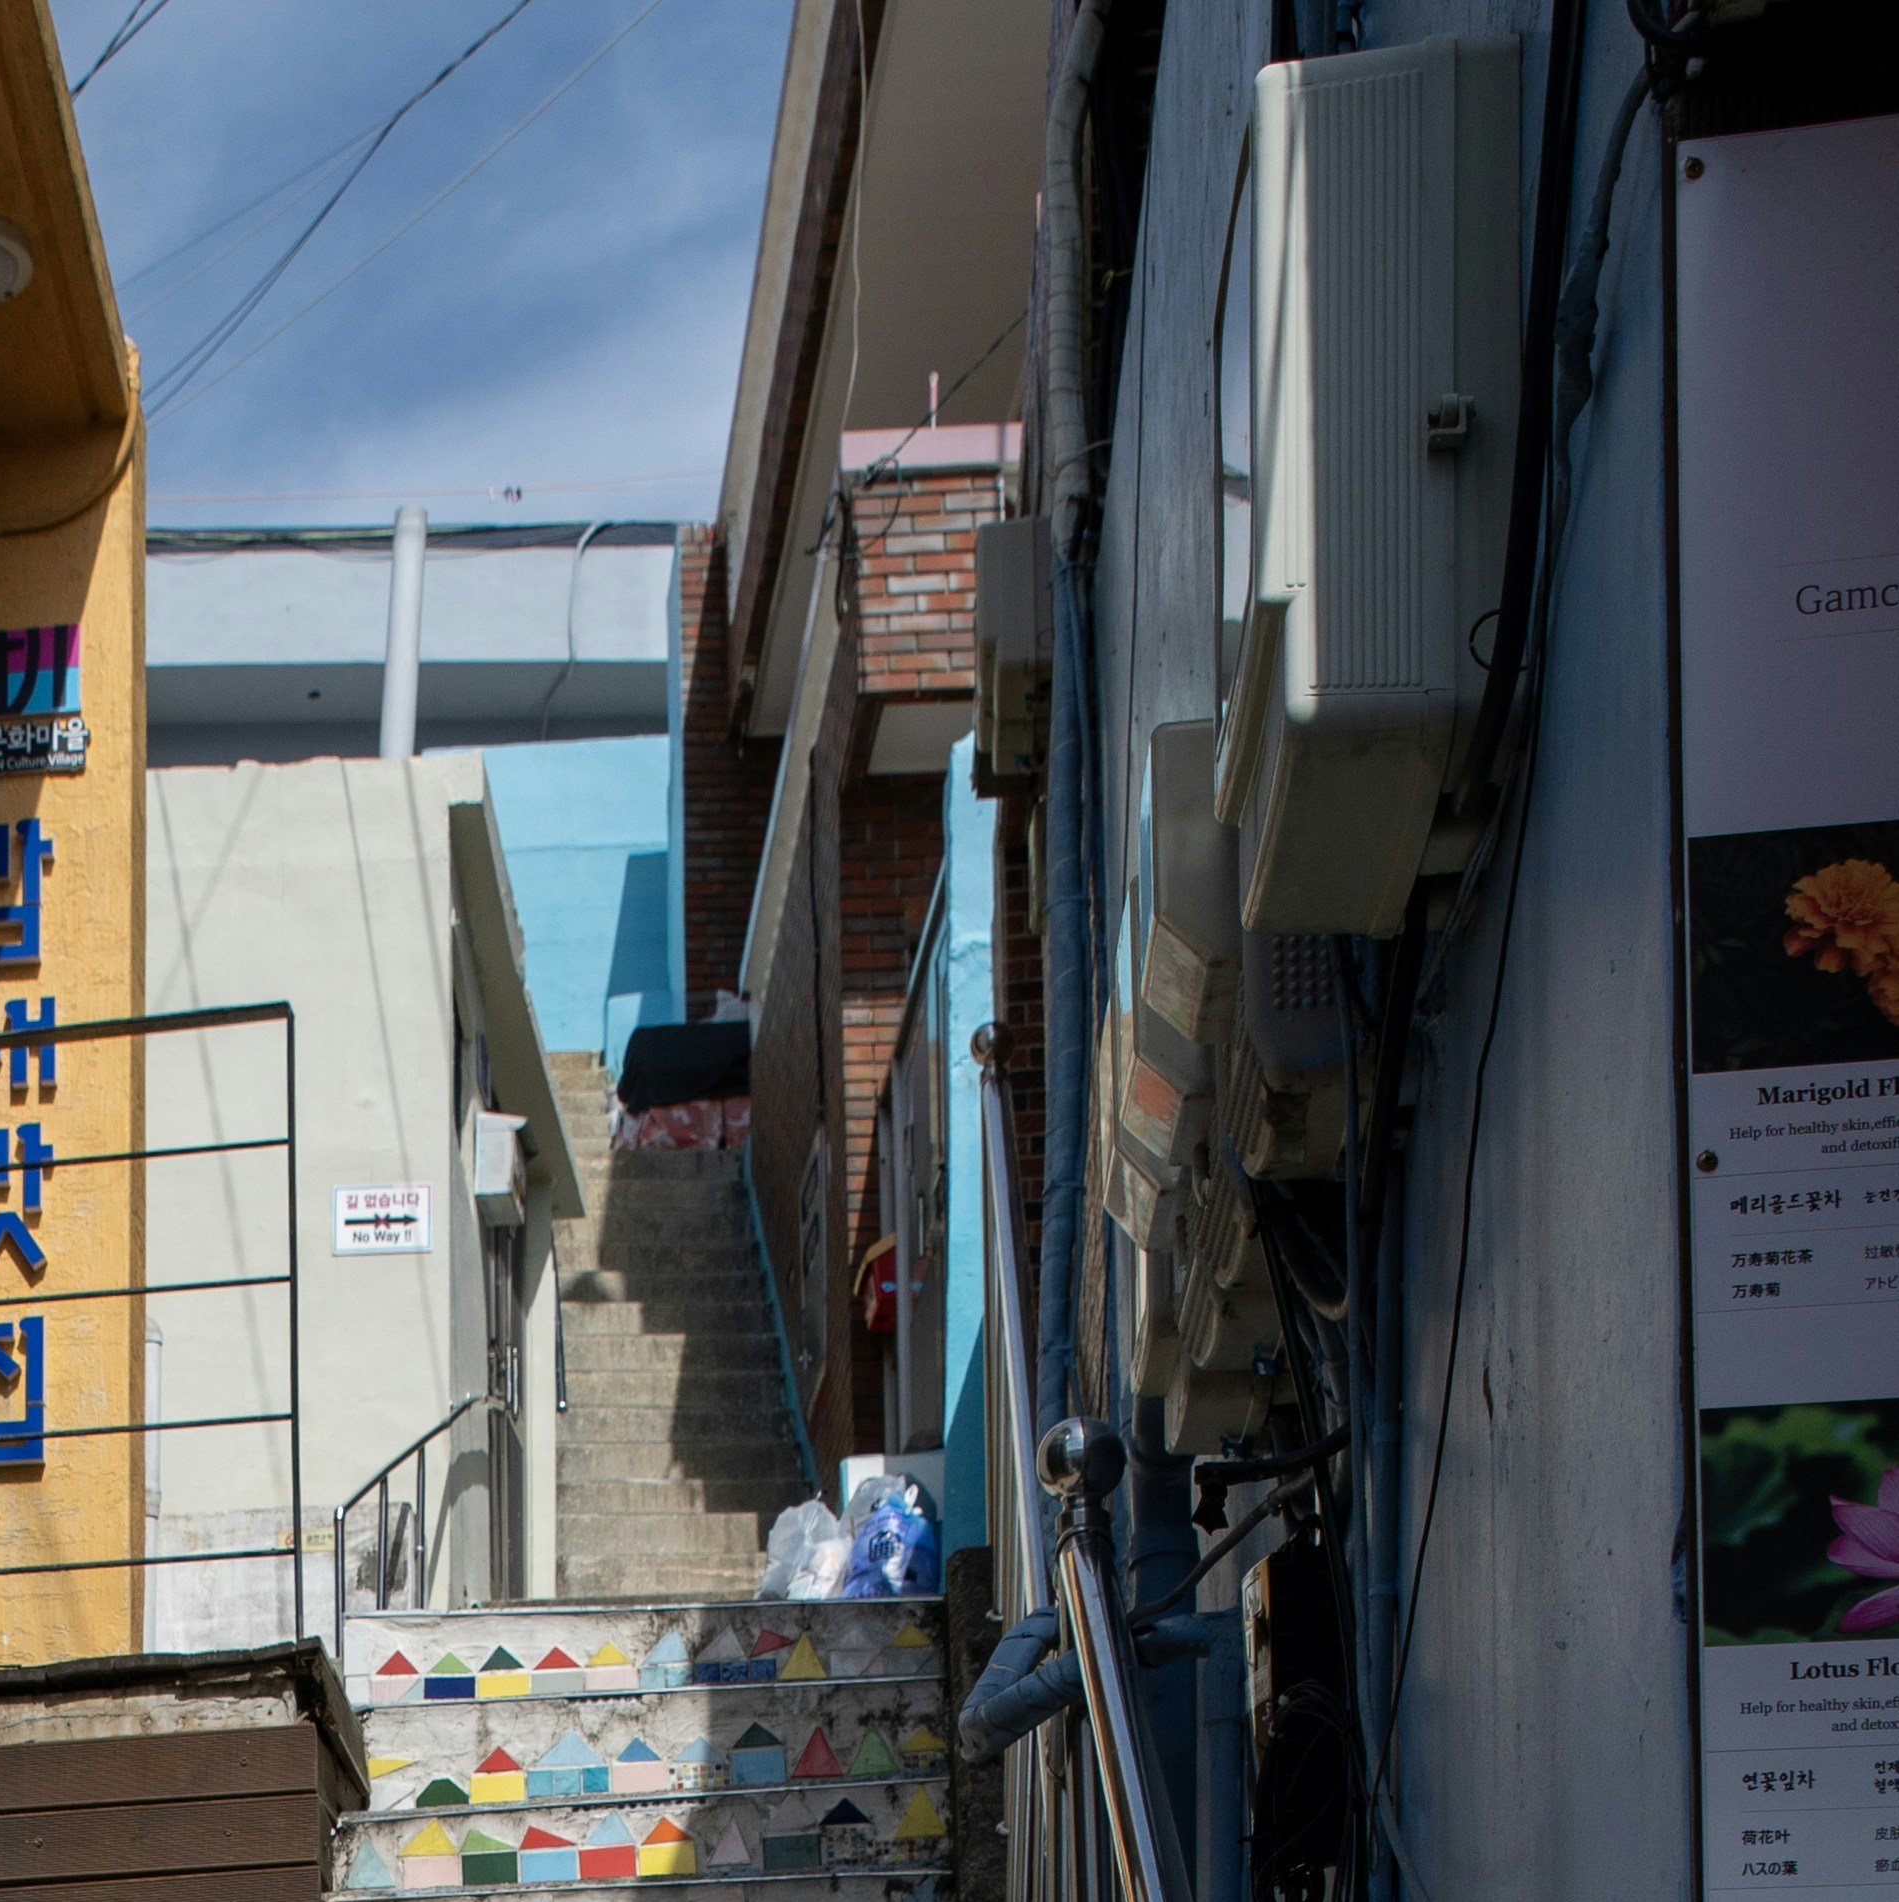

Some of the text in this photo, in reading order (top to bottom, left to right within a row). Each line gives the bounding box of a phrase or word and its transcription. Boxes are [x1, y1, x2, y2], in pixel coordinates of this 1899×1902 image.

[1796, 583, 1899, 615] Gamc
[7, 757, 46, 770] Culture
[47, 752, 84, 766] Village
[1757, 1078, 1870, 1106] Marigold
[1729, 1120, 1839, 1141] Help for healthy
[1821, 1140, 1846, 1154] and
[364, 1192, 419, 1208] 없습니다
[1730, 1189, 1842, 1215] 메리골드꽃차
[353, 1231, 370, 1242] No
[374, 1230, 400, 1244] Way
[1731, 1249, 1813, 1268] 万寿菊花茶
[1732, 1282, 1781, 1299] 万寿菊
[1790, 1661, 1859, 1680] Lotus
[1740, 1699, 1848, 1716] Help for healthy
[1832, 1720, 1857, 1732] and
[1742, 1769, 1816, 1792] 연꽃잎차
[1741, 1829, 1790, 1845] 荷花叶
[1742, 1861, 1798, 1876] ハスの葉
